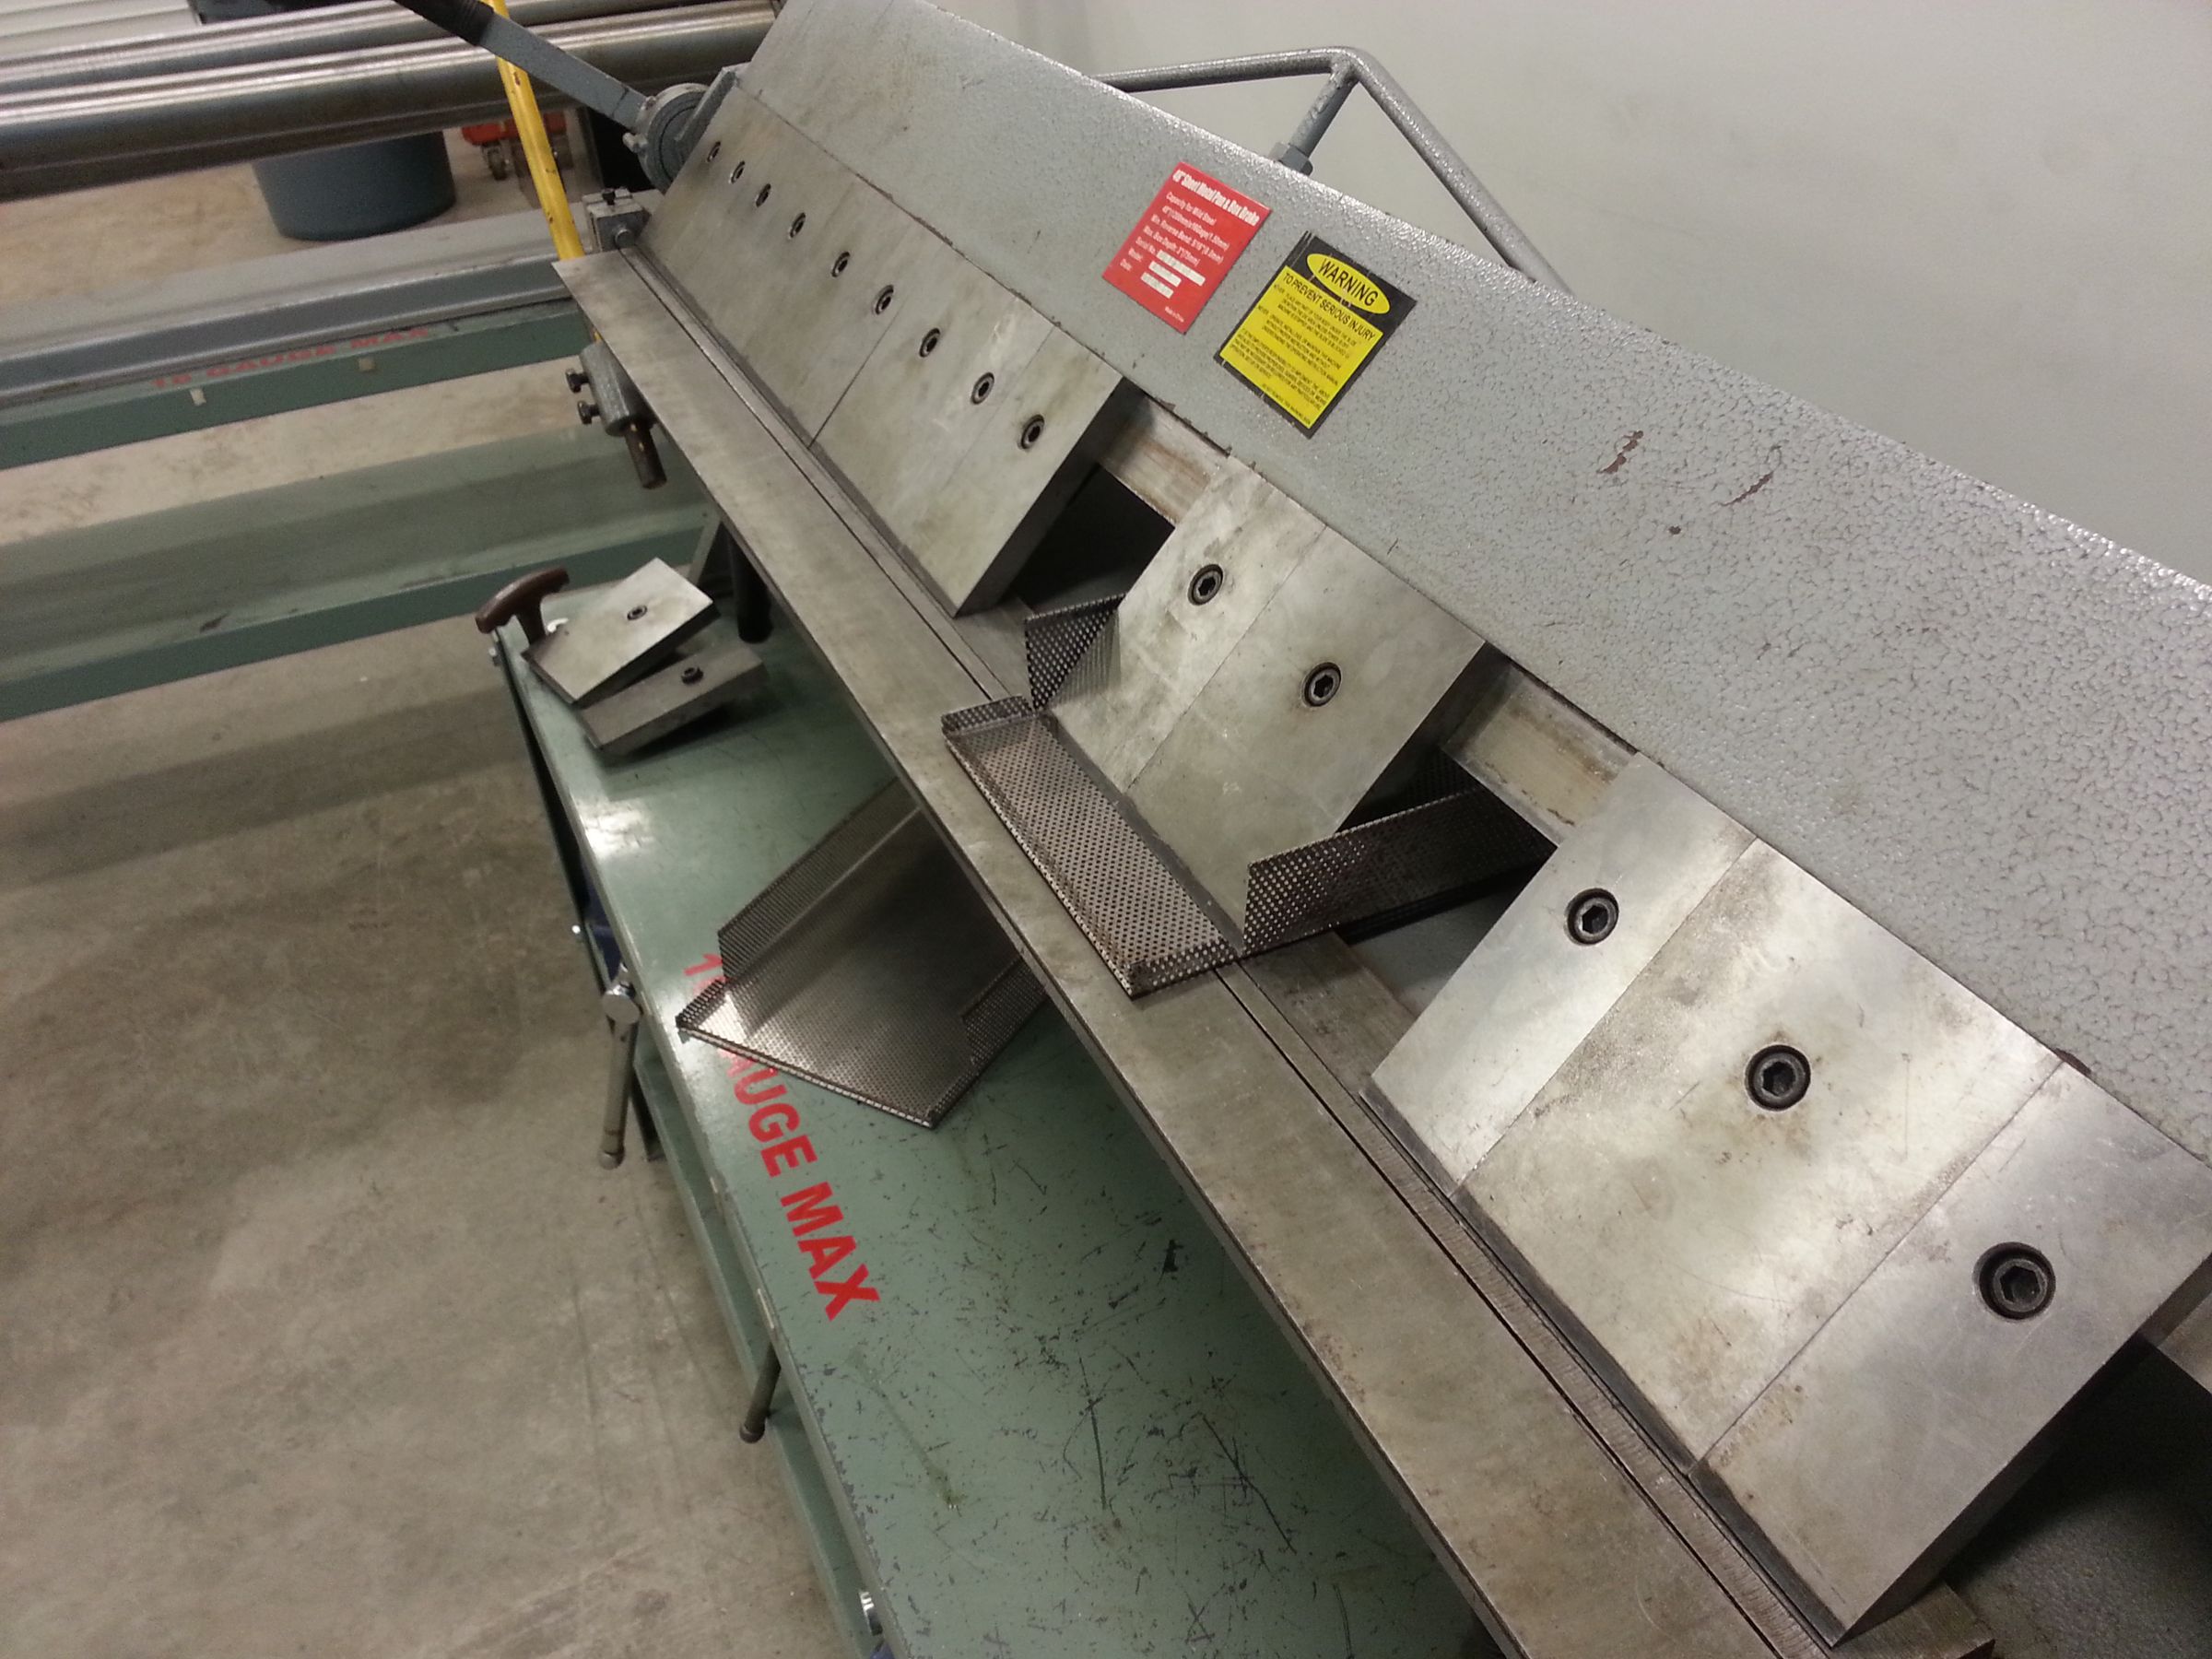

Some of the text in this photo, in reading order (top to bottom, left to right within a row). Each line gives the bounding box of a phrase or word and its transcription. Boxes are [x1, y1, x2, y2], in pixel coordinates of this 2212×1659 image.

[1283, 272, 1375, 342] TO PREVENT SERIOUS INJURY
[1318, 258, 1378, 306] WARNING
[780, 1181, 881, 1322] MAX
